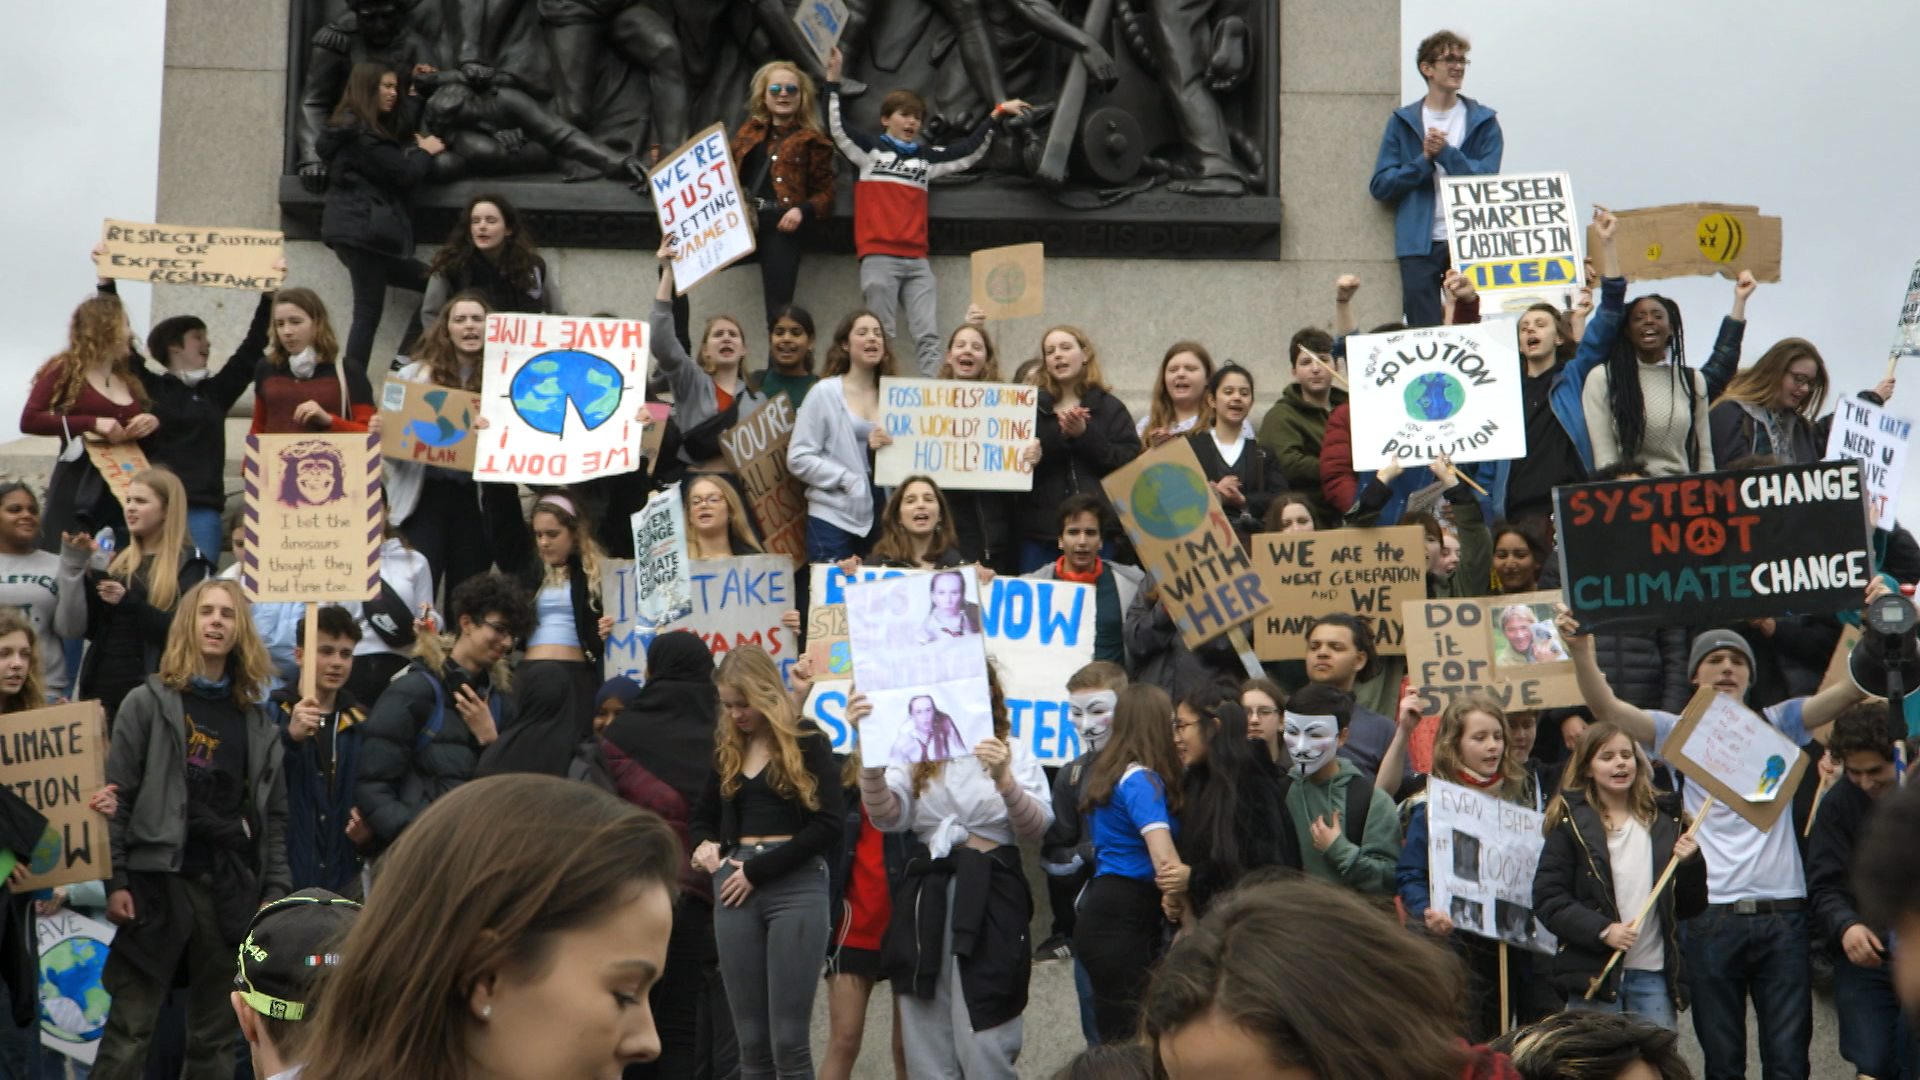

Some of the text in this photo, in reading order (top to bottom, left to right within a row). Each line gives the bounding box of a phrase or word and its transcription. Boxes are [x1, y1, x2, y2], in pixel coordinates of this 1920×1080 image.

[654, 134, 724, 194] WE'RE
[662, 160, 727, 226] JUST
[1501, 177, 1564, 202] SEEN
[1453, 202, 1567, 232] SMARTER
[106, 225, 199, 244] RESPECT
[1456, 227, 1573, 260] CABINETS IN
[111, 254, 204, 269] EXPECT
[175, 245, 209, 255] OR
[149, 268, 277, 289] RESISTANCE
[1476, 259, 1567, 287] IKEA
[488, 316, 643, 349] HAVE TIME
[1376, 341, 1497, 388] SOLUTION
[885, 413, 914, 437] OUR
[1844, 399, 1873, 427] THE
[721, 395, 794, 469] YOU'RE
[1380, 418, 1500, 460] POLLUTION
[413, 439, 457, 462] PLAN
[582, 447, 630, 475] WE
[1881, 445, 1894, 466] U
[1568, 477, 1738, 527] SYSTEM
[1739, 465, 1861, 509] CHANGE
[280, 513, 290, 530] I
[326, 512, 351, 529] the
[281, 535, 341, 550] dinosaurs
[1164, 530, 1219, 573] I'M
[1268, 538, 1405, 568] WE ARE the
[324, 554, 353, 576] they
[1163, 544, 1250, 603] WITH
[1281, 565, 1421, 586] NEXT GENERATION
[690, 566, 787, 614] TAKE
[1572, 549, 1869, 612] CLIMATE CHANGE
[1185, 571, 1271, 636] HER
[1350, 585, 1393, 613] WE
[1267, 615, 1311, 637] HAV
[1424, 602, 1482, 629] DO
[0, 720, 84, 767] LIMATE
[9, 774, 82, 811] TION
[1440, 788, 1483, 821] EVEN
[38, 914, 83, 945] AVE
